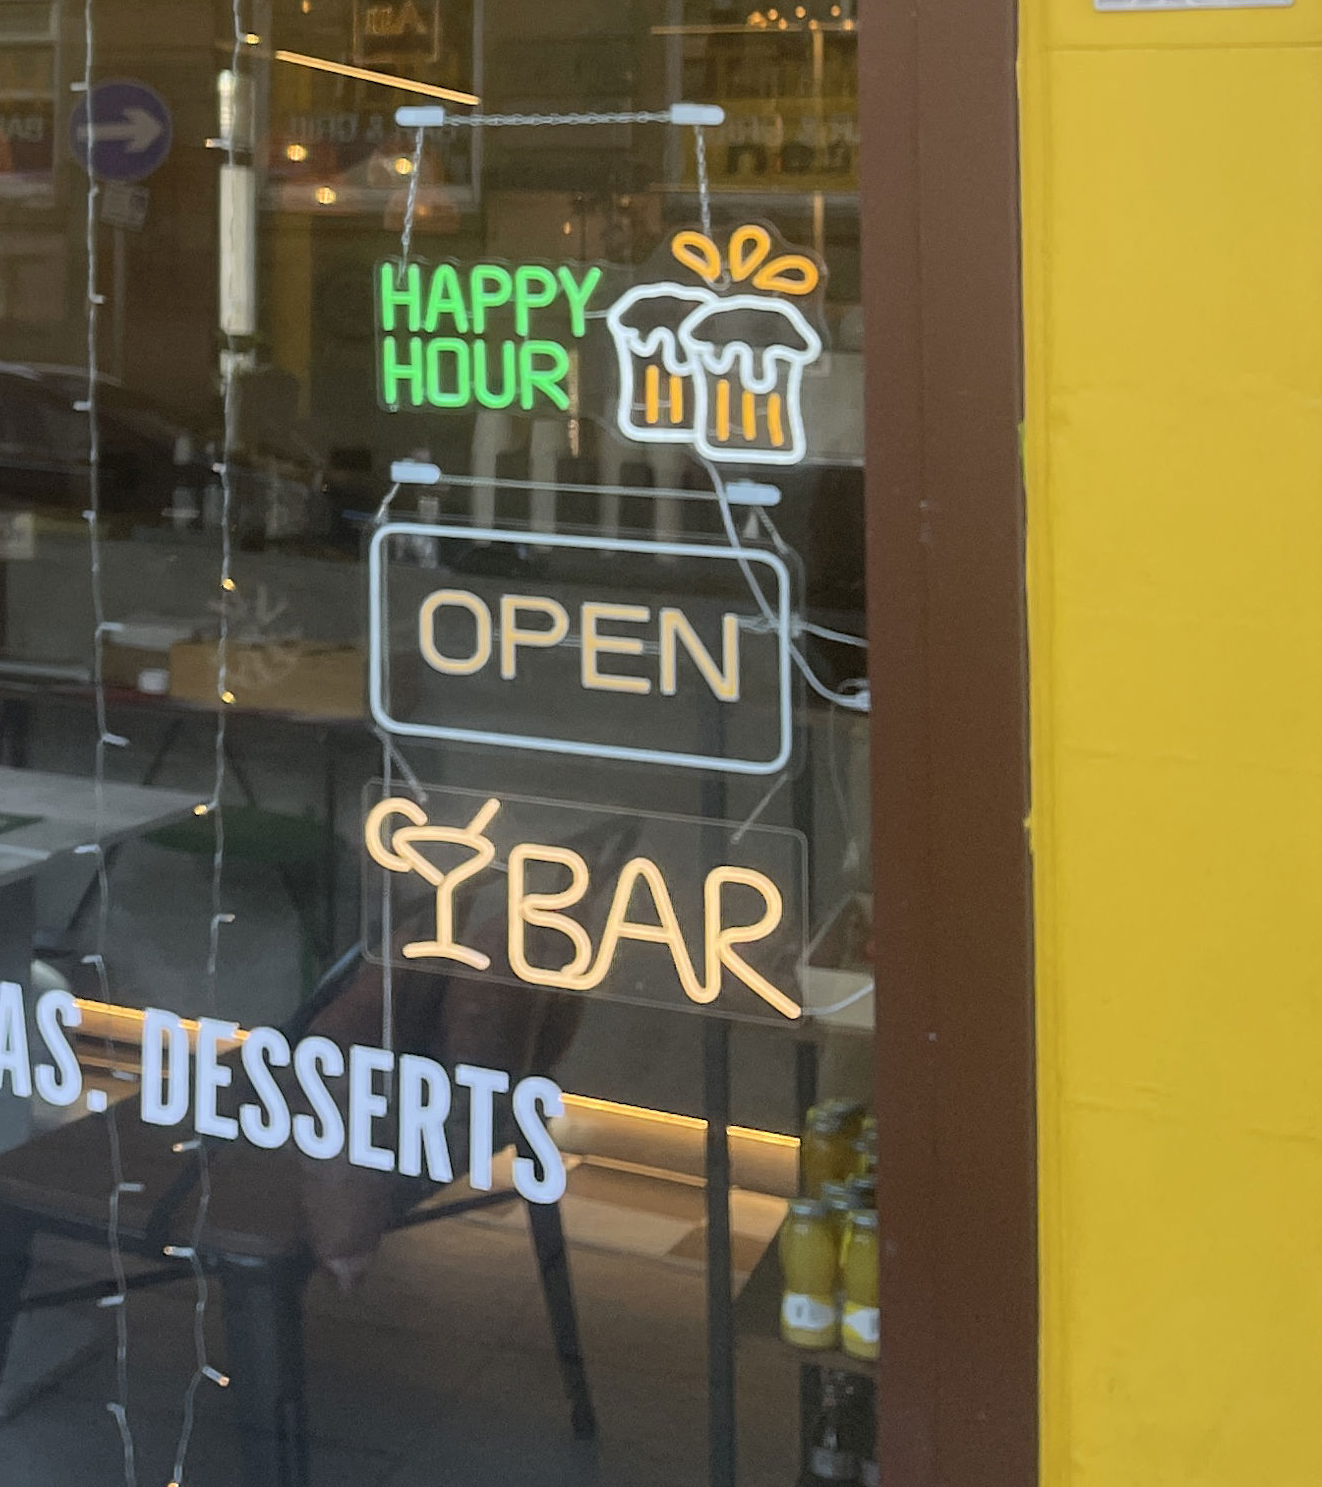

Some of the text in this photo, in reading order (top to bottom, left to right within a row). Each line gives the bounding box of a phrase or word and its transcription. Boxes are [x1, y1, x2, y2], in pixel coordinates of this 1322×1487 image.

[381, 263, 603, 337] HAPPY
[383, 336, 570, 410] HOUR
[419, 588, 740, 702] OPEN
[508, 843, 801, 1019] BAR
[140, 1007, 567, 1205] DESSERTS
